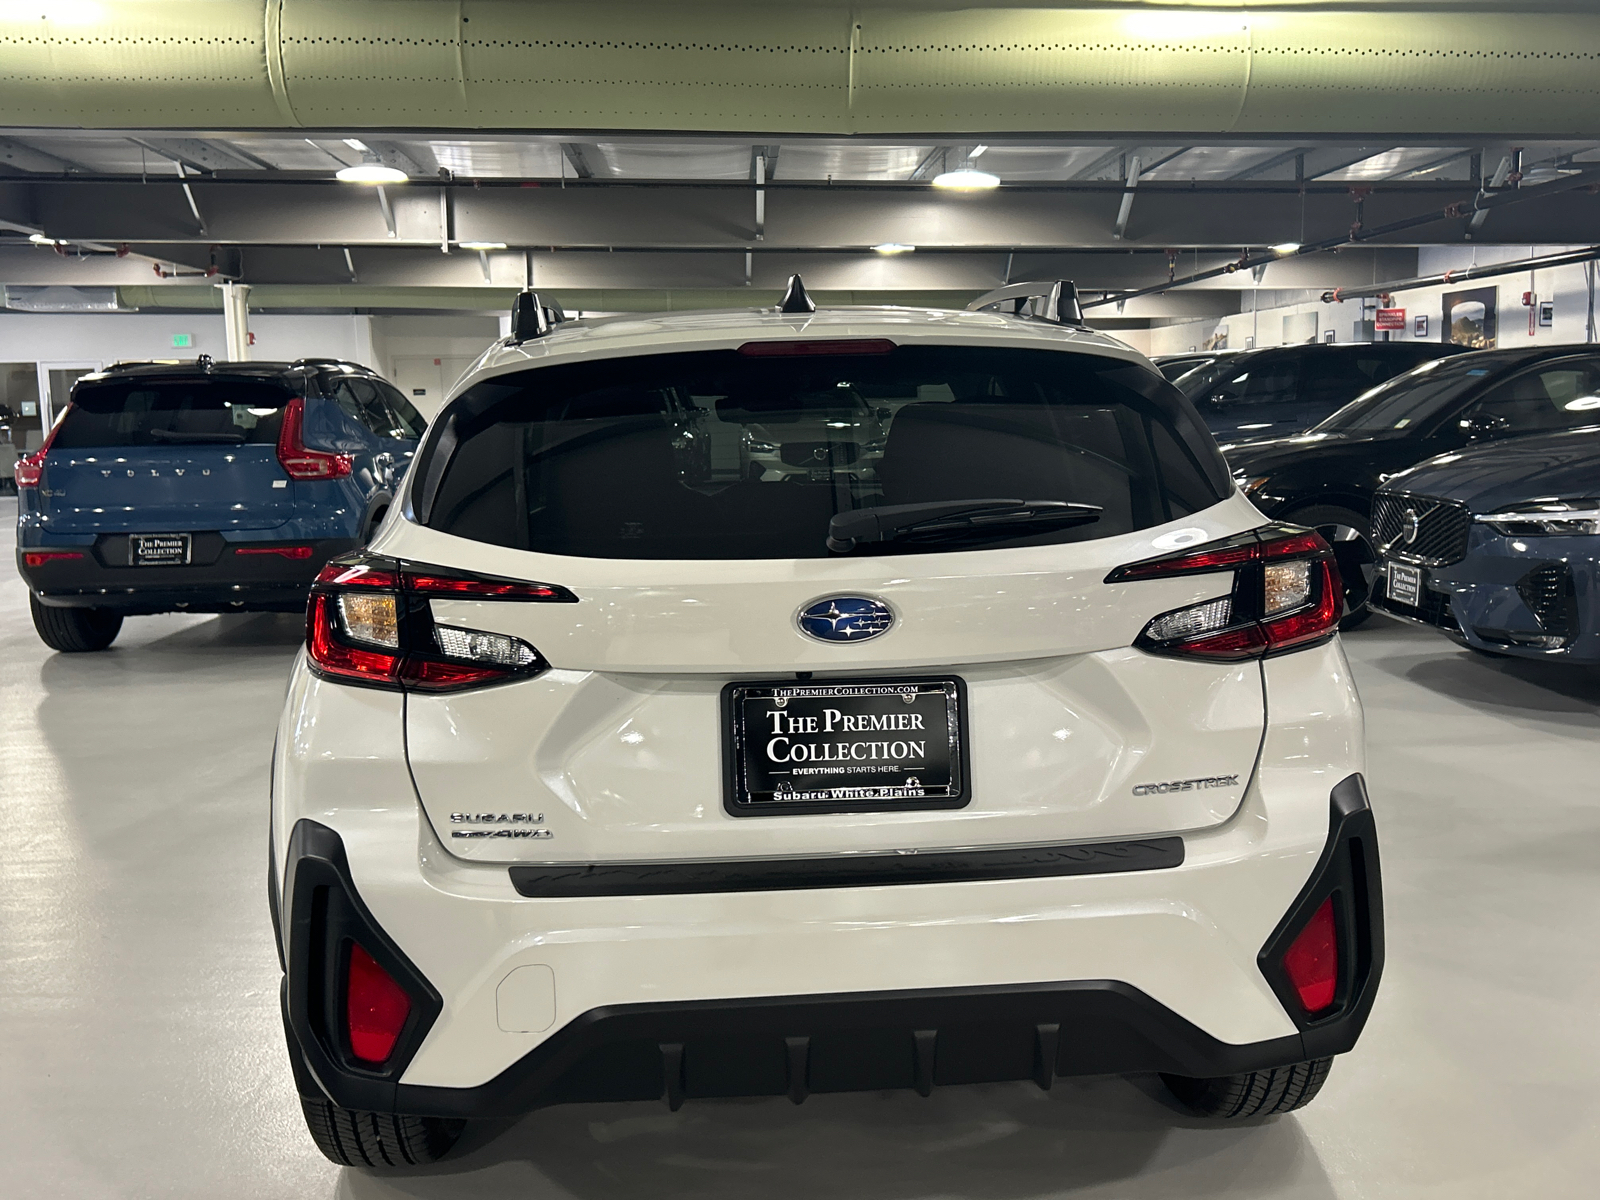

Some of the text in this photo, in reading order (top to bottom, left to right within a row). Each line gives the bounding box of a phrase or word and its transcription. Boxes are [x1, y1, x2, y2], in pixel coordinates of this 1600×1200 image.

[101, 469, 210, 477] VOLVO
[766, 708, 925, 734] THE PREMIER
[766, 737, 926, 763] COLLECTION
[792, 767, 845, 775] EVERYTHING
[846, 766, 876, 774] STARTS
[1132, 774, 1239, 796] CROSSTREK
[773, 788, 925, 800] Subaru White Plains
[450, 813, 544, 824] SUBARU
